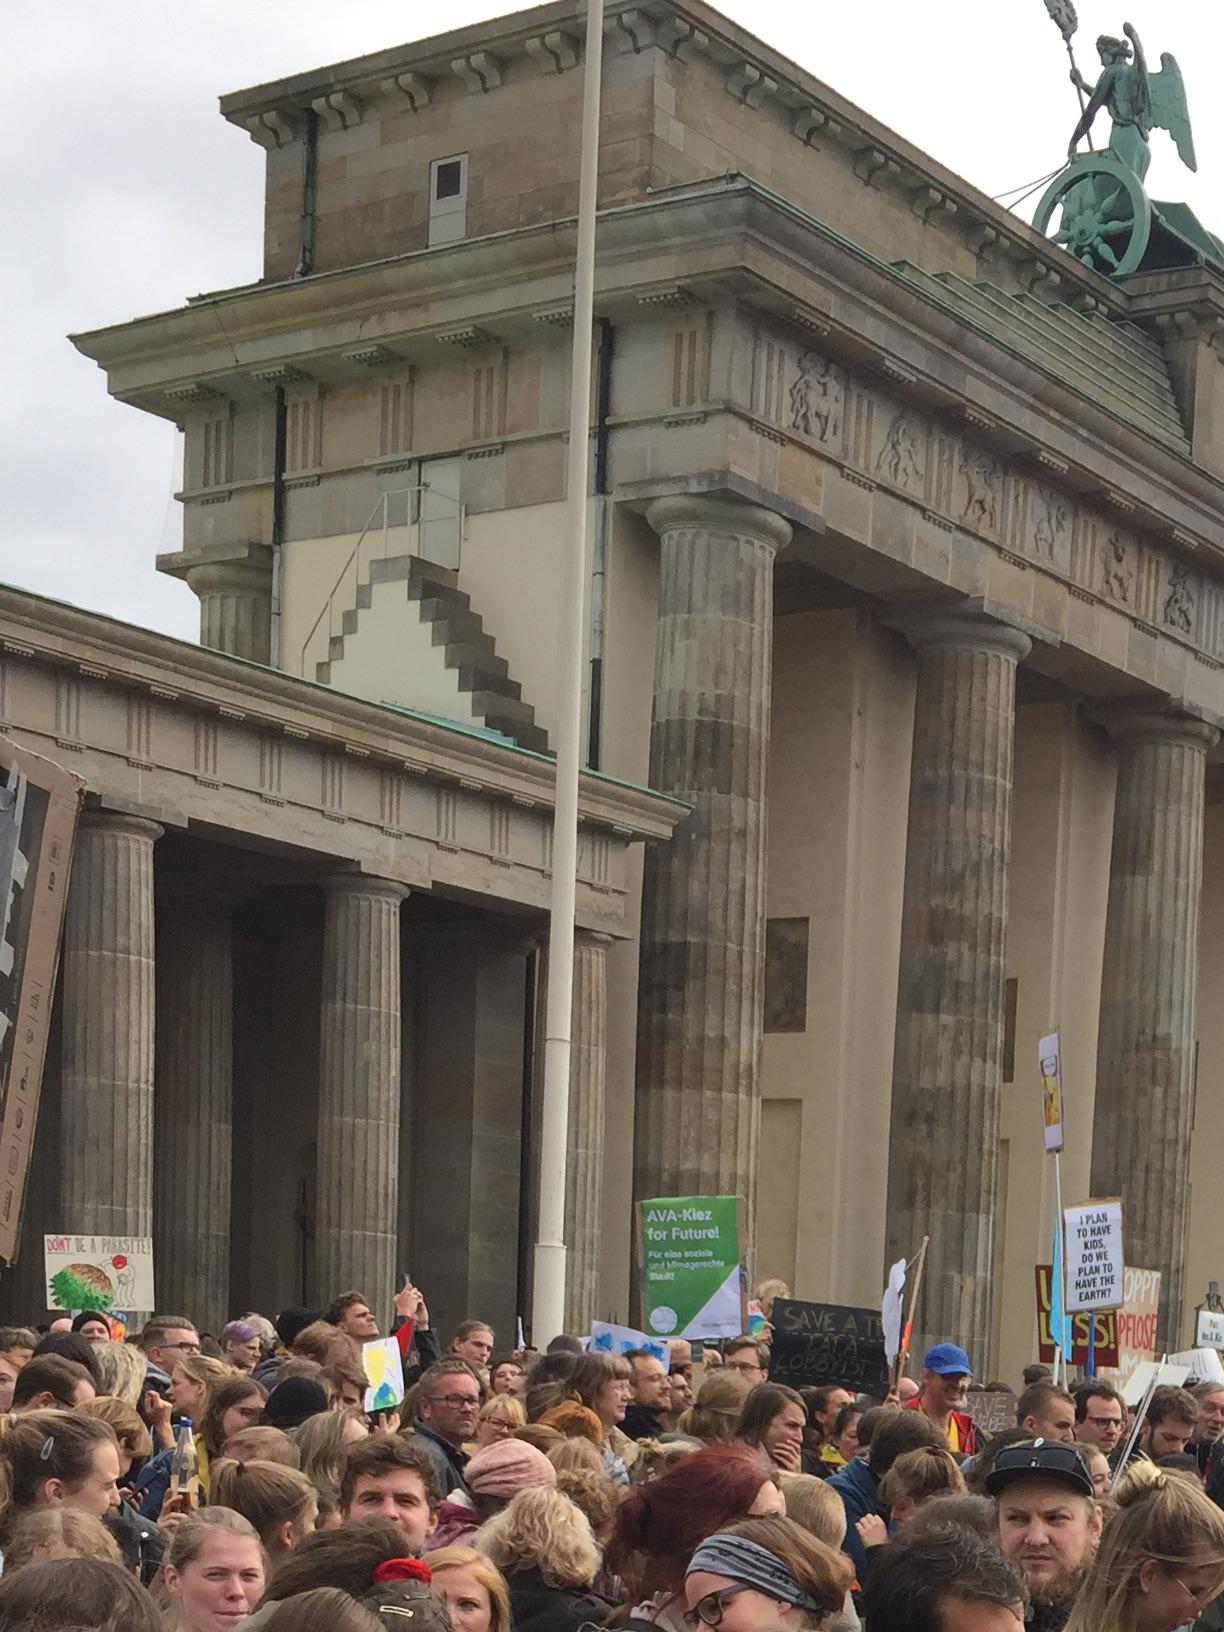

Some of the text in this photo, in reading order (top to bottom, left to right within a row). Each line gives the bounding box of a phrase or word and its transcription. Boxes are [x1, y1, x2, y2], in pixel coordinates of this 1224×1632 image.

[647, 1208, 712, 1222] AVA-Kiez
[1080, 1212, 1108, 1225] I PLAN
[647, 1226, 719, 1240] for Future!
[1077, 1225, 1111, 1238] TO HAVE
[1083, 1239, 1106, 1250] KIDS,
[1081, 1251, 1109, 1264] DO WE
[1077, 1262, 1113, 1277] PLAN TO
[1075, 1275, 1115, 1290] HAVE THE
[1124, 1270, 1160, 1304] OPPT
[1079, 1288, 1112, 1302] EARTH?
[782, 1306, 836, 1332] SAVE
[842, 1312, 859, 1335] A
[864, 1314, 884, 1338] TR
[1039, 1311, 1116, 1350] LSS!
